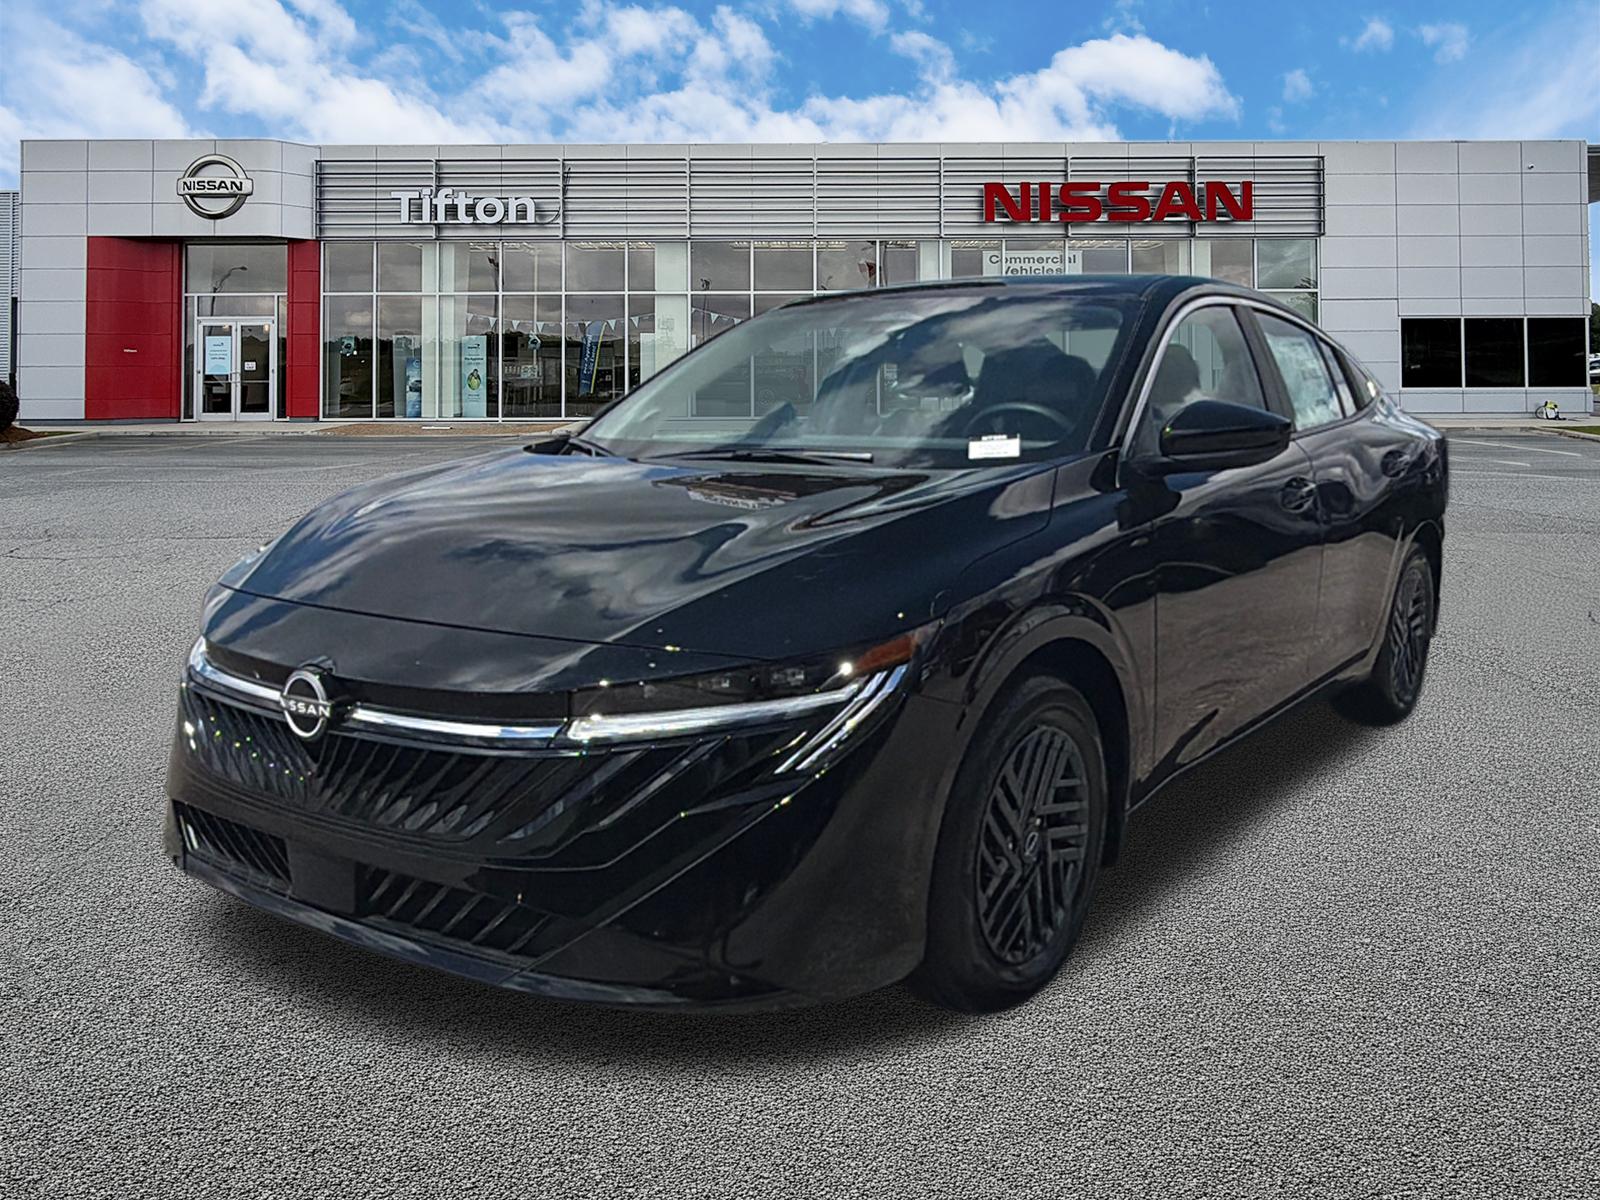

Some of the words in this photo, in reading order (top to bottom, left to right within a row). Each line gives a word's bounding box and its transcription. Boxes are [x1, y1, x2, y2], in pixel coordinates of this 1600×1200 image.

[182, 180, 243, 191] NISSAN
[391, 188, 536, 224] Tifton
[984, 181, 1254, 222] NISSAN
[281, 699, 331, 718] SSAN
